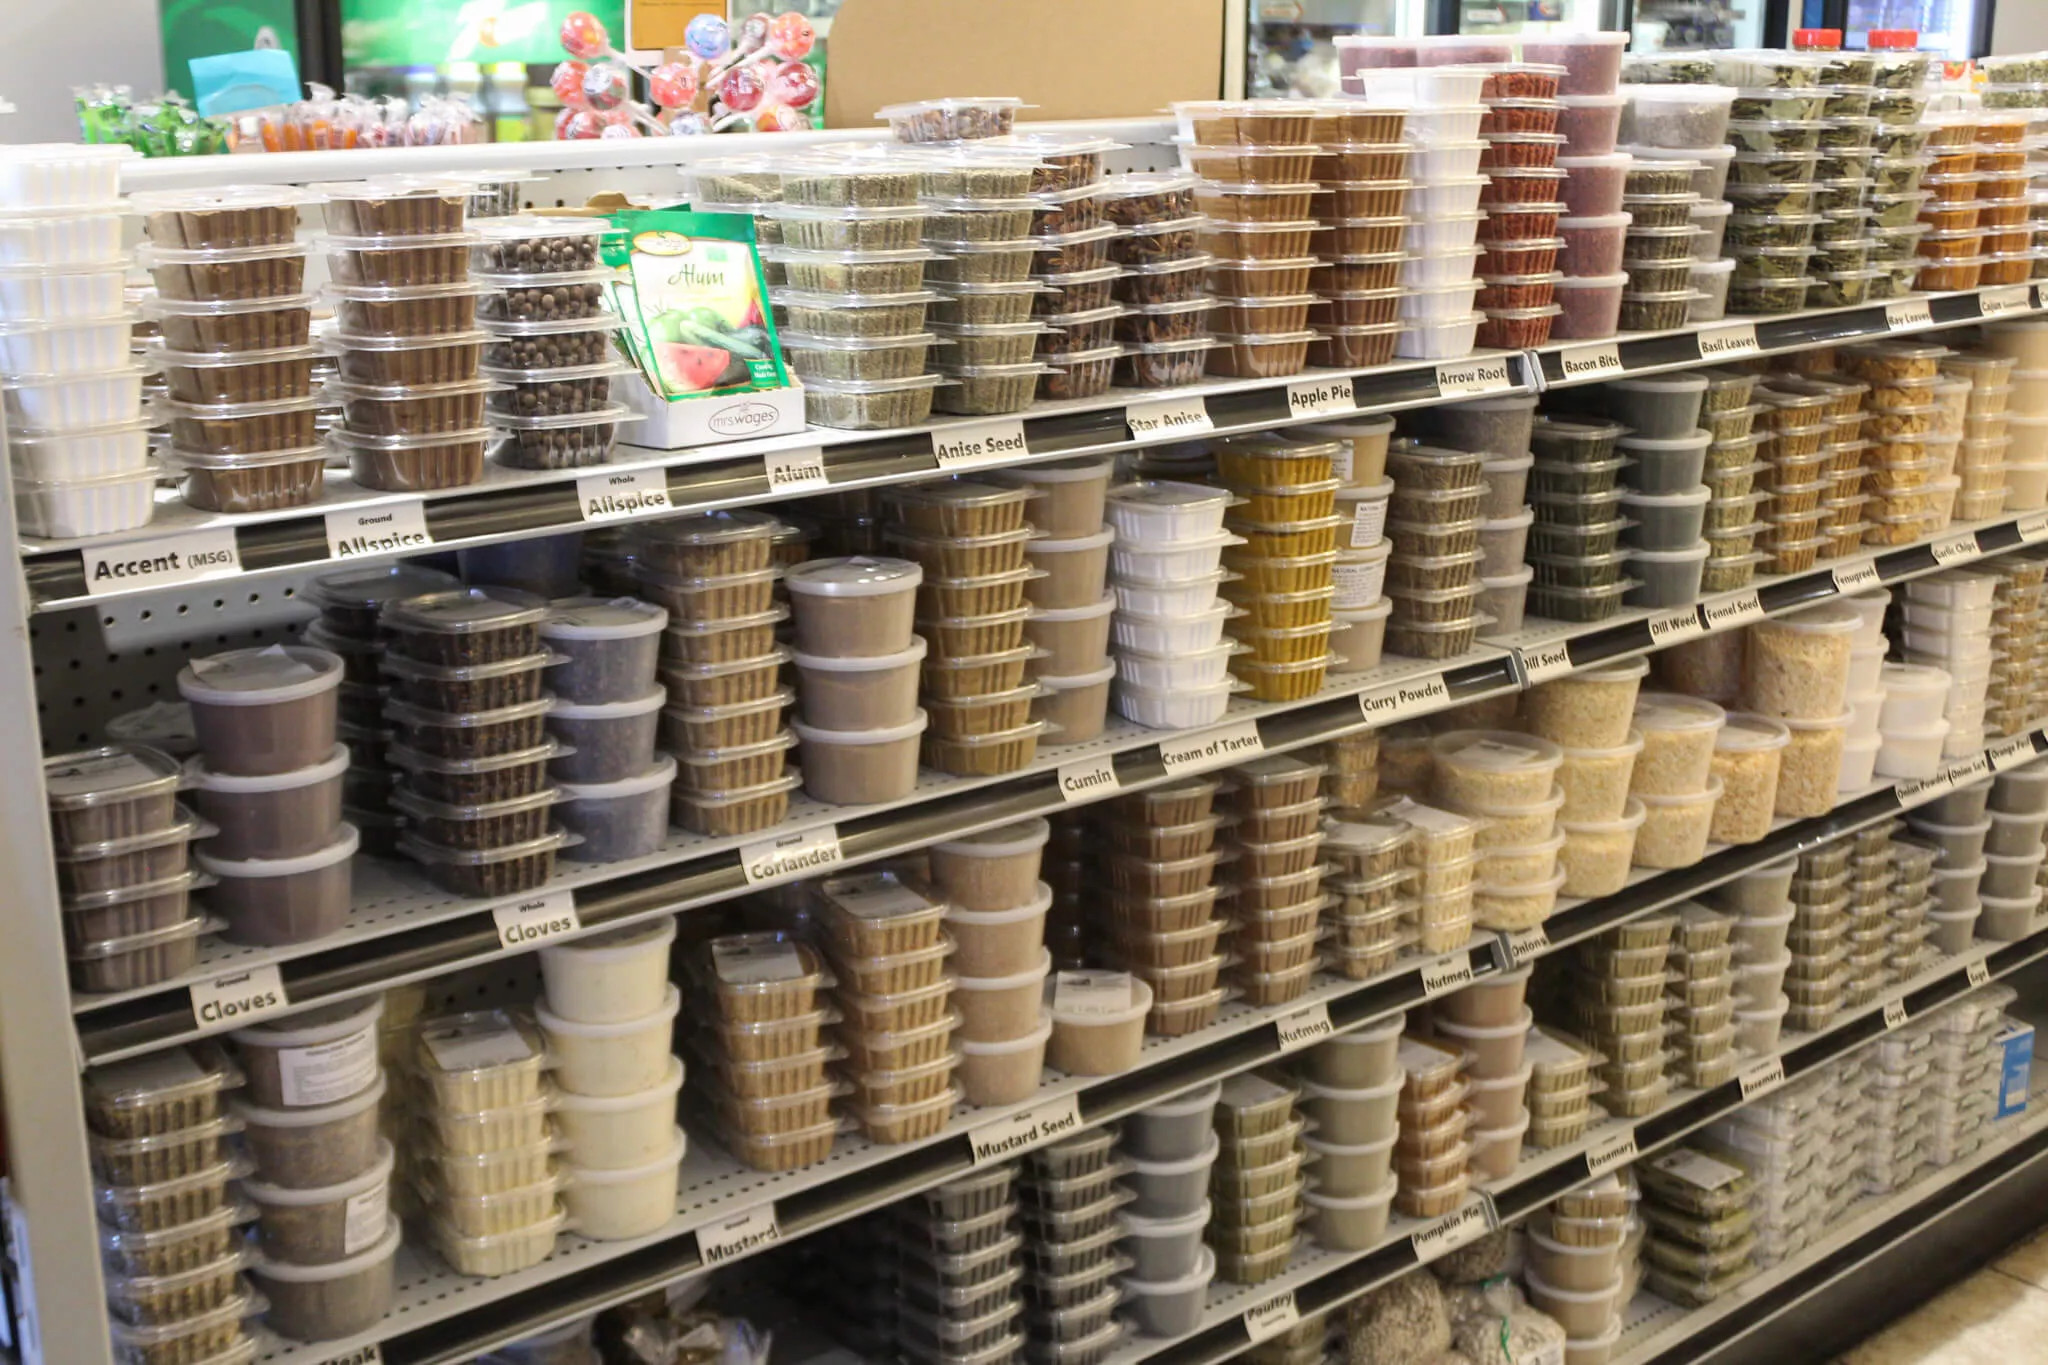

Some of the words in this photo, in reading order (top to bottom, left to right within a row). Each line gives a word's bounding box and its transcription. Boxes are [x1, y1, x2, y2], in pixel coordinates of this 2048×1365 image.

[667, 264, 726, 287] Alum
[1702, 337, 1724, 354] Basil
[1726, 333, 1758, 349] Leaves
[1440, 371, 1475, 385] Arrow
[1478, 367, 1505, 381] Root
[1565, 358, 1596, 373] Bacon
[1599, 354, 1620, 367] Bits
[1291, 390, 1328, 408] Apple
[1331, 386, 1351, 400] Pie
[1129, 417, 1160, 433] Star
[1164, 411, 1204, 427] Anise
[938, 441, 982, 459] Anise
[986, 434, 1025, 453] Seed
[608, 474, 636, 485] Whole
[773, 465, 822, 484] Alum
[588, 490, 666, 516] Allspice
[358, 514, 393, 526] Ground
[338, 531, 425, 557] Allspice
[94, 552, 182, 580] Accent
[187, 549, 234, 570] (MSG)
[1834, 567, 1876, 586] Fenugreek
[1707, 602, 1736, 620] Fennel
[1738, 597, 1758, 612] Seed
[1652, 621, 1669, 635] Dill
[1671, 613, 1698, 629] Weed
[1541, 647, 1567, 664] Seed
[1363, 697, 1396, 714] Curry
[1398, 684, 1444, 705] Powder
[1163, 748, 1202, 765] Cream
[1206, 743, 1219, 755] of
[1220, 734, 1258, 753] Tarter
[1066, 768, 1111, 793] Cumin
[751, 847, 836, 880] Coriander
[505, 914, 571, 945] Cloves
[1511, 936, 1547, 957] Onions
[1426, 969, 1470, 991] Nutmeg
[200, 989, 277, 1023] Cloves
[1279, 1020, 1330, 1045] Nutmeg
[1743, 1067, 1782, 1094] Rosemary
[976, 1125, 1038, 1159] Mustard
[1041, 1112, 1075, 1136] Seed
[1589, 1141, 1633, 1169] Rosemary
[1414, 1216, 1460, 1246] Pumpkin
[1462, 1207, 1479, 1222] Pie
[706, 1222, 778, 1263] Mustard
[1247, 1291, 1292, 1321] Poultry
